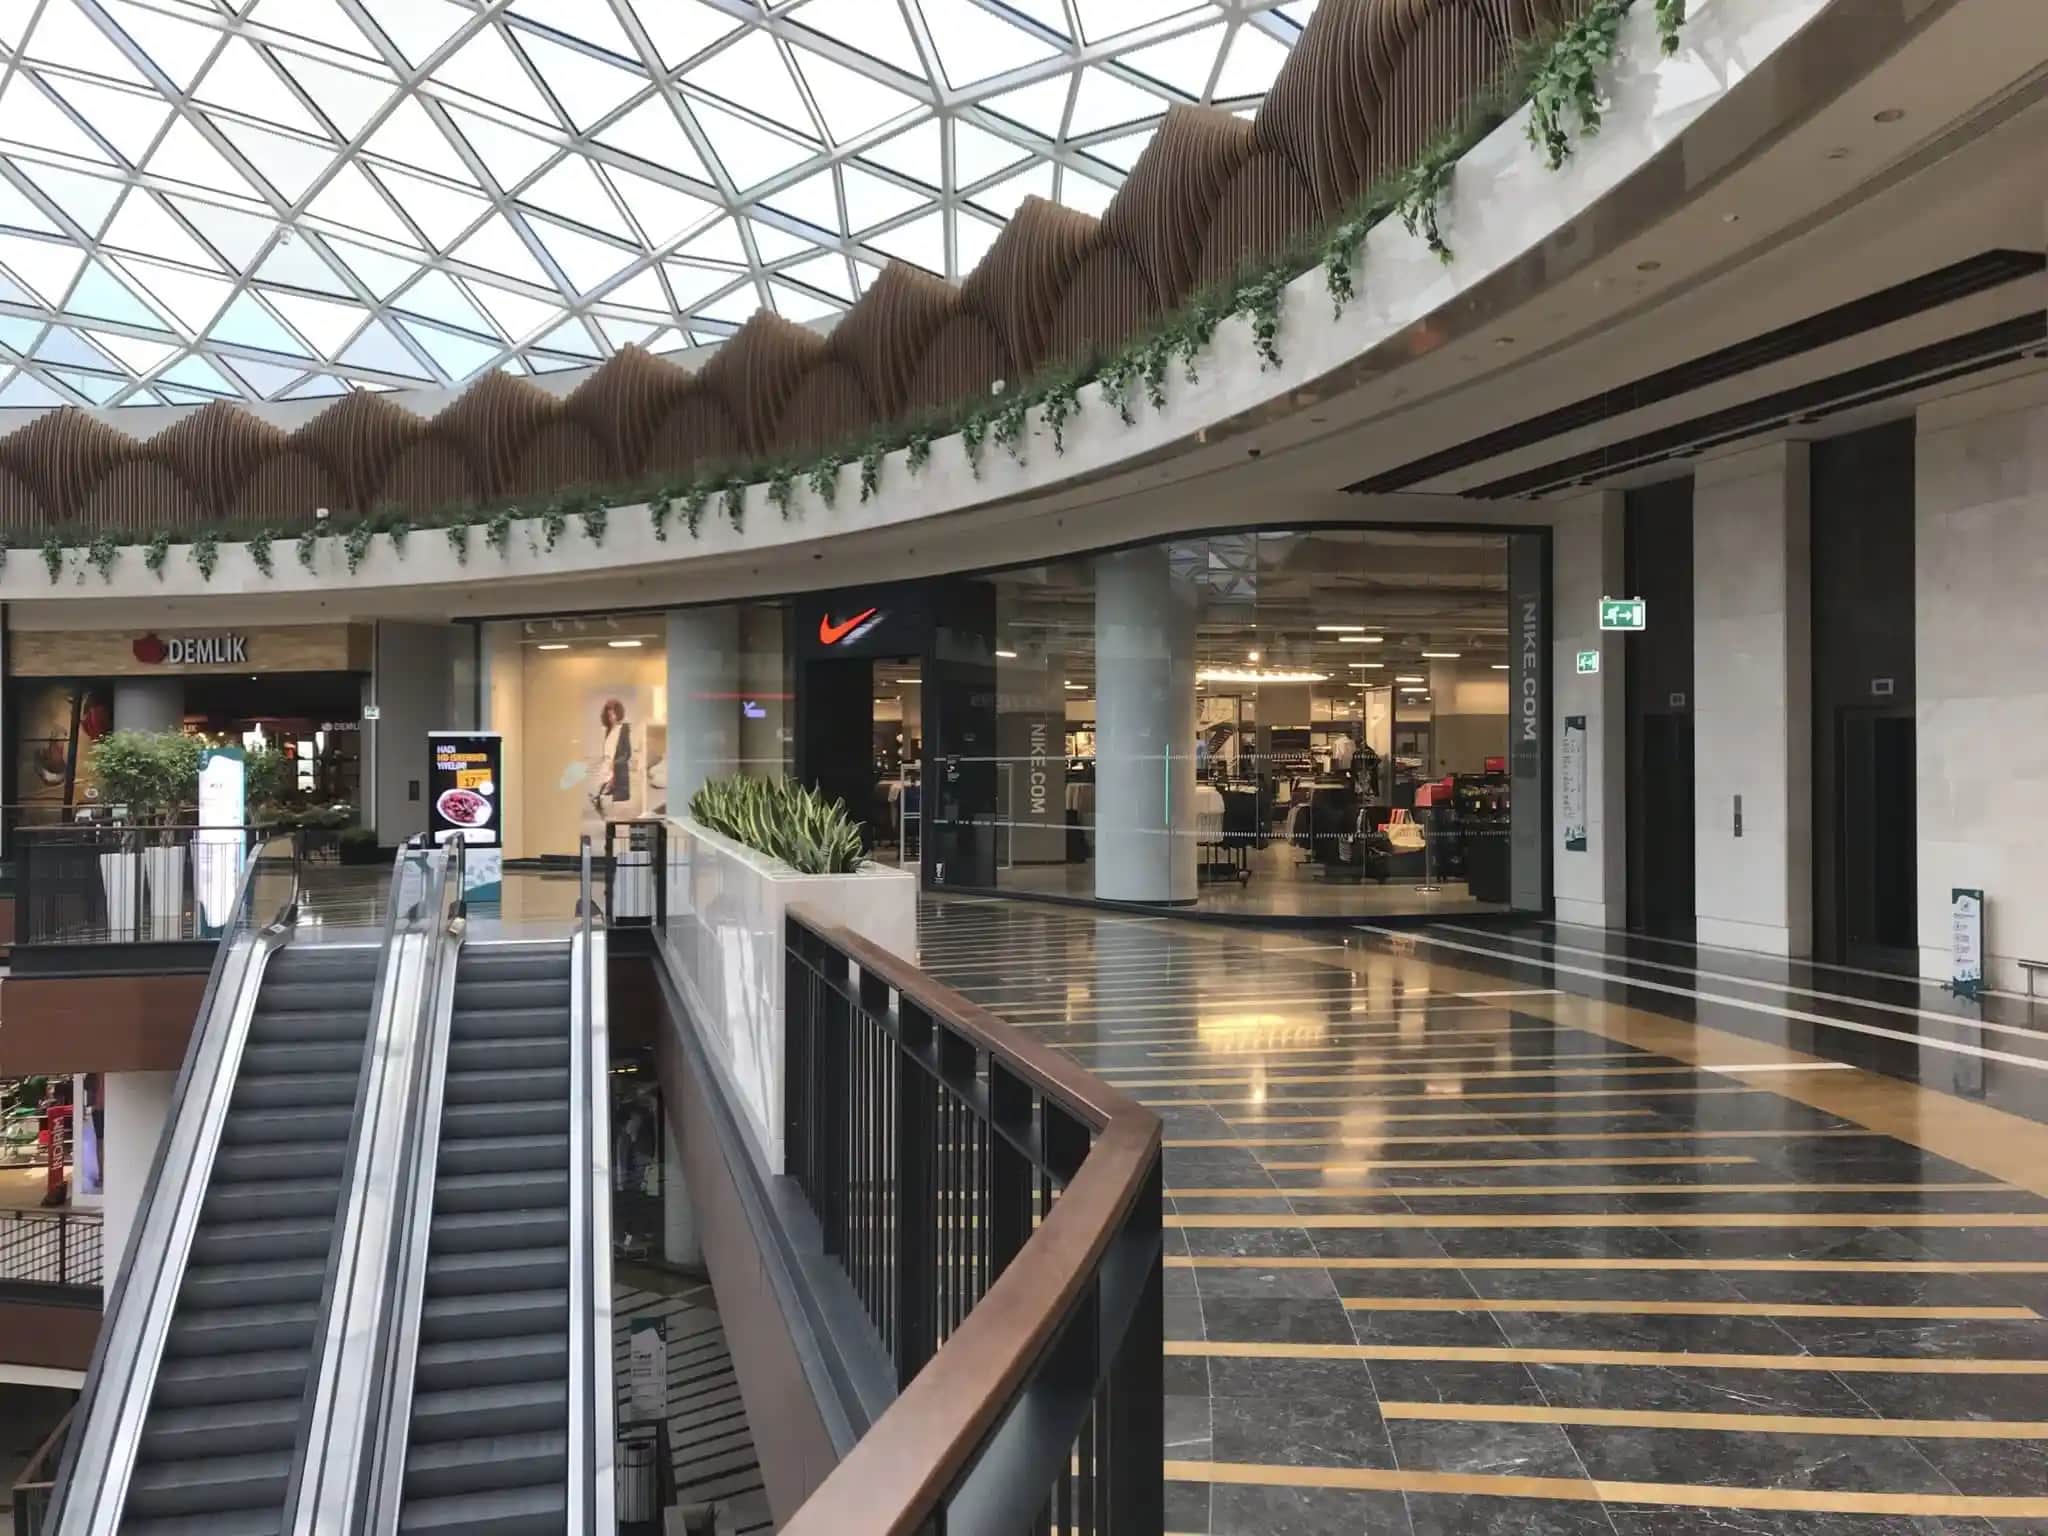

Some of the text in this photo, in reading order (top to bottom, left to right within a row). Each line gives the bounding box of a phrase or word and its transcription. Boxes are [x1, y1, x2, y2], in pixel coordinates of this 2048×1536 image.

[168, 632, 246, 663] DEMLİK
[1523, 602, 1537, 740] NIKE.COM
[1031, 723, 1047, 814] NIKE.COM
